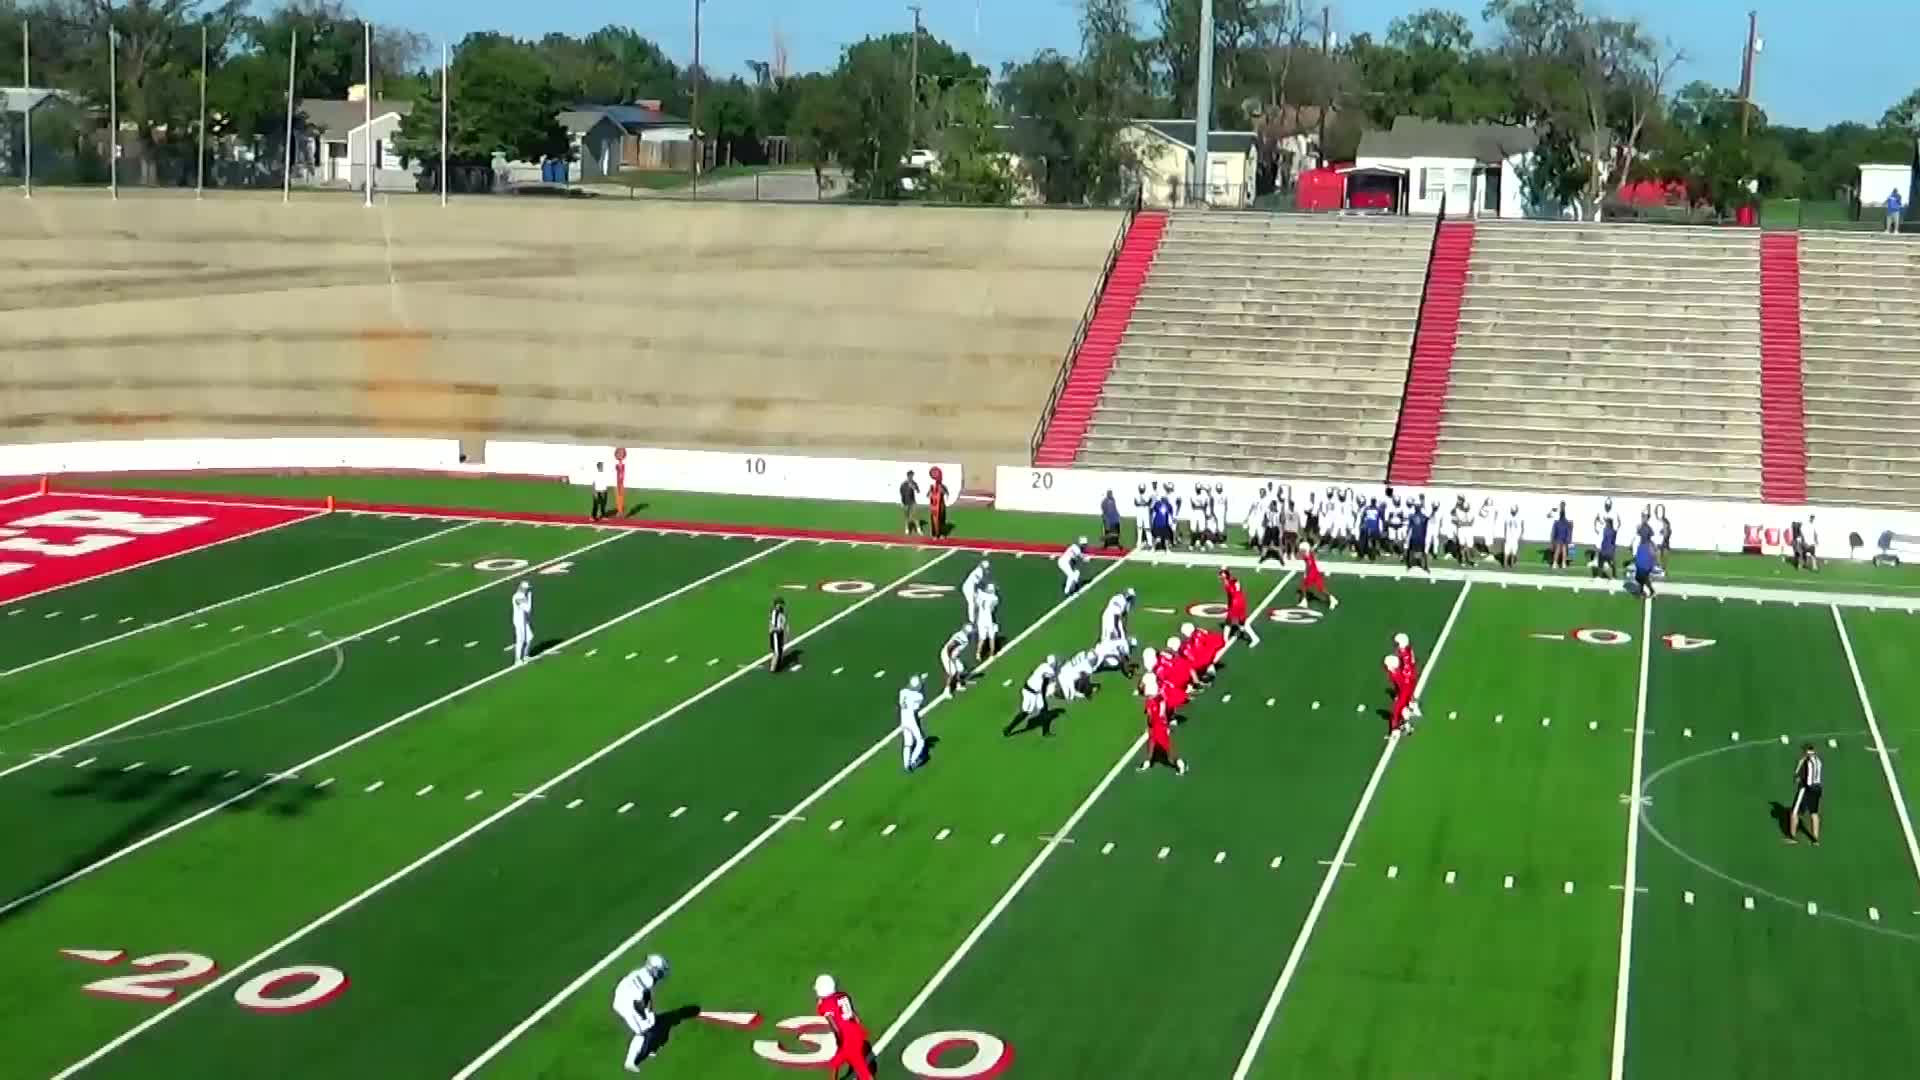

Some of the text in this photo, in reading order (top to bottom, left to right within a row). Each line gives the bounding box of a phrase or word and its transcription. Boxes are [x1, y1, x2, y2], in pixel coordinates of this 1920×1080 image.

[745, 457, 766, 475] 10
[1031, 471, 1054, 490] 20
[817, 579, 956, 599] 20
[1571, 628, 1717, 651] 40
[80, 951, 352, 1014] 20
[752, 1014, 1016, 1080] 30
